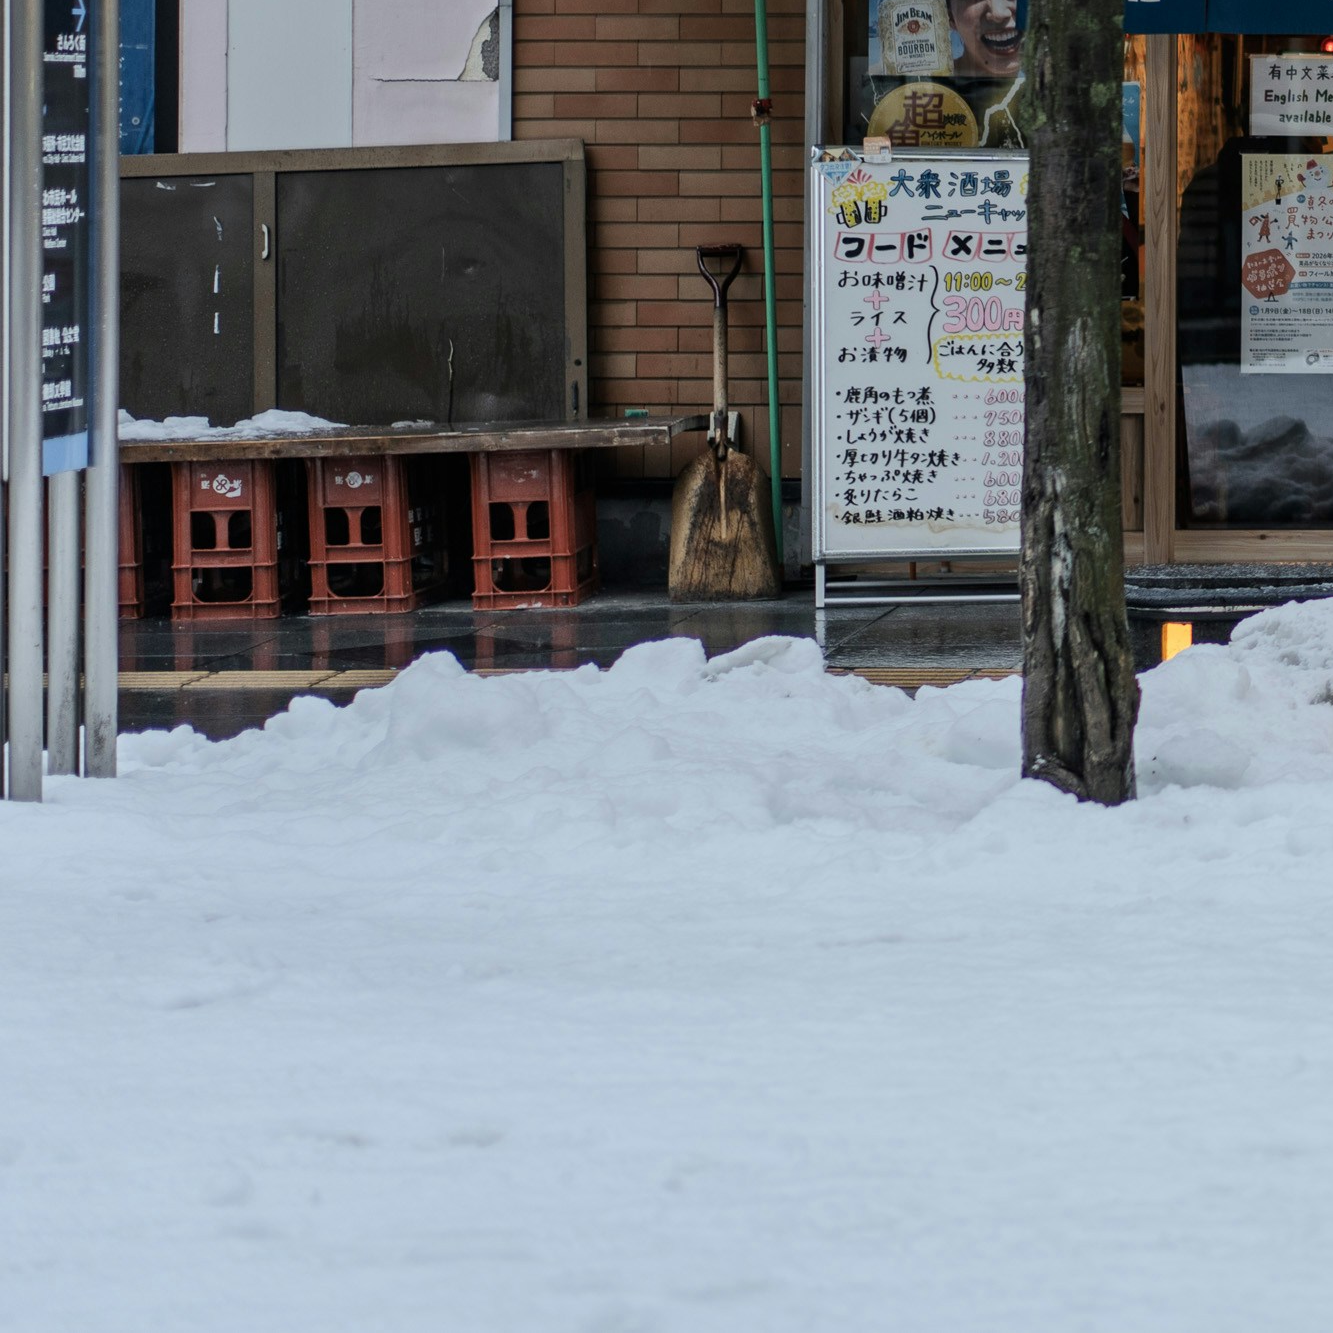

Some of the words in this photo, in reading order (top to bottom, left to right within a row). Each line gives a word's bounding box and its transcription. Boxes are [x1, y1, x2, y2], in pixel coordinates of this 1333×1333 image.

[895, 10, 910, 26] JIM
[910, 8, 932, 23] BEAM
[897, 44, 935, 56] BOURBON
[1264, 89, 1308, 104] English
[1279, 110, 1331, 123] available
[920, 129, 963, 139] ハイボール
[889, 169, 1013, 198] 大衆酒場
[841, 232, 930, 259] フード
[838, 270, 928, 292] お味噌汁
[850, 311, 907, 326] ライス
[838, 346, 907, 363] お漬物
[846, 425, 929, 444] しょうが焼き
[842, 448, 960, 468] 厚切り牛タン焼き
[844, 488, 918, 506] 炙りたらこ
